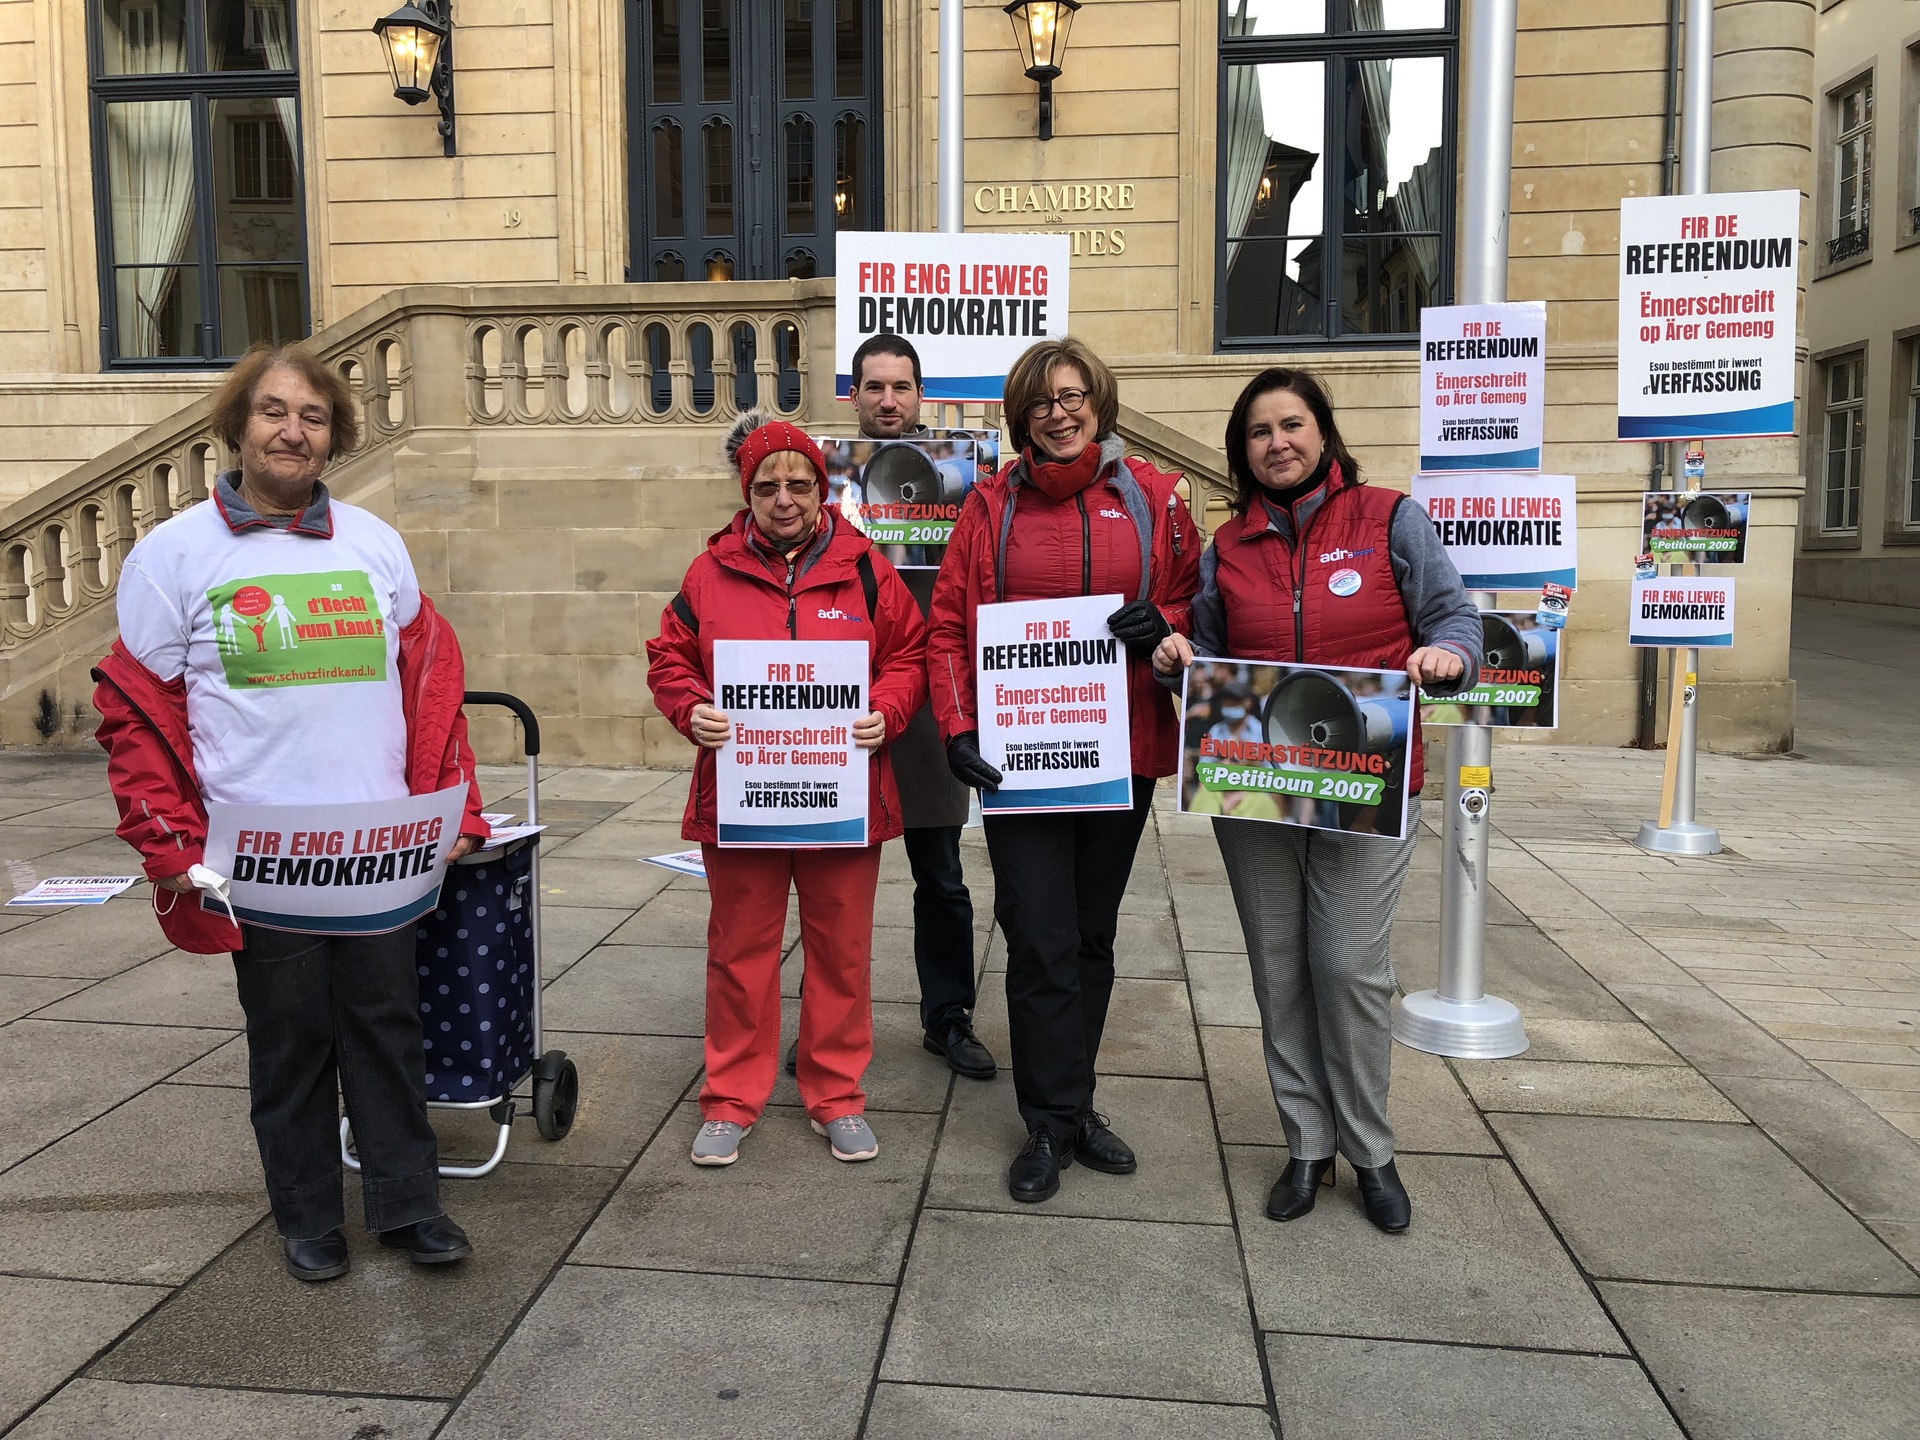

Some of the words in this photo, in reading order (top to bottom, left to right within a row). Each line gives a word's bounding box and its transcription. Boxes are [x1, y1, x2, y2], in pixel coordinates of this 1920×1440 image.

[974, 184, 1136, 213] CHAMBRE
[503, 210, 522, 228] 19
[1045, 214, 1064, 223] DES
[1681, 216, 1708, 239] FIR
[1715, 215, 1738, 238] DE
[1626, 237, 1792, 275] REFERENDUM
[859, 262, 895, 293] FIR
[904, 263, 950, 294] ENG
[959, 264, 1048, 296] LIEWEG
[1640, 289, 1775, 318] Ënnerschreift
[858, 296, 1048, 337] DEMOKRATIE
[1463, 323, 1482, 338] FIR
[1486, 322, 1501, 337] DE
[1640, 324, 1660, 344] op
[1666, 319, 1701, 341] Ärer
[1706, 320, 1774, 340] Gemeng
[1426, 337, 1538, 361] REFERENDUM
[1649, 361, 1670, 371] Esou
[1672, 359, 1716, 371] bestëmmt
[1717, 358, 1729, 369] Dir
[1731, 357, 1762, 368] iwwert
[1436, 372, 1527, 390] Ënnerschreift
[1643, 370, 1762, 395] d'VERFASSUNG
[1436, 394, 1450, 407] op
[1453, 390, 1478, 405] Ärer
[1481, 391, 1527, 405] Gemeng
[1442, 418, 1456, 426] Esou
[1438, 425, 1519, 442] d'VERFASSUNG
[1429, 497, 1456, 519] FIR
[1462, 497, 1496, 519] ENG
[1501, 497, 1562, 519] LIEWEG
[909, 526, 955, 542] 2007
[1708, 540, 1736, 550] 2007
[307, 595, 367, 614] d'Recht
[1642, 590, 1660, 603] FIR
[1663, 590, 1684, 604] ENG
[1688, 591, 1726, 604] LIEWEG
[1641, 603, 1725, 620] DEMOKRATIE
[295, 622, 333, 639] vum
[334, 619, 375, 637] Kand
[1025, 621, 1048, 641] FIR
[1053, 620, 1071, 639] DE
[982, 638, 1117, 671] REFERENDUM
[246, 665, 377, 684] www.schutzfirdkand.lu
[768, 664, 790, 682] FIR
[796, 664, 815, 682] DE
[722, 684, 860, 710] REFERENDUM
[995, 682, 1106, 707] Ënnerschreift
[1494, 689, 1538, 704] 2007
[996, 710, 1014, 728] op
[1017, 706, 1046, 725] Ärer
[1050, 707, 1107, 725] Gemeng
[735, 723, 847, 746] Ënnerschreift
[1005, 742, 1022, 751] Esou
[1024, 740, 1060, 751] bestëmmt
[1062, 740, 1072, 750] Dir
[1073, 739, 1099, 749] iwwert
[736, 751, 753, 766] op
[757, 746, 787, 765] Ärer
[791, 749, 847, 767] Gemeng
[1001, 750, 1100, 772] d'VERFASSUNG
[1200, 732, 1384, 774] ËNNERSTËTZUNG
[745, 780, 762, 789] Esou
[763, 780, 801, 790] bestëmmt
[802, 780, 812, 790] Dir
[813, 780, 838, 790] iwwert
[1319, 777, 1379, 801] 2007
[236, 829, 282, 856] FIR
[290, 830, 344, 856] ENG
[353, 816, 443, 855] LIEWEG
[232, 842, 439, 887] DEMOKRATIE
